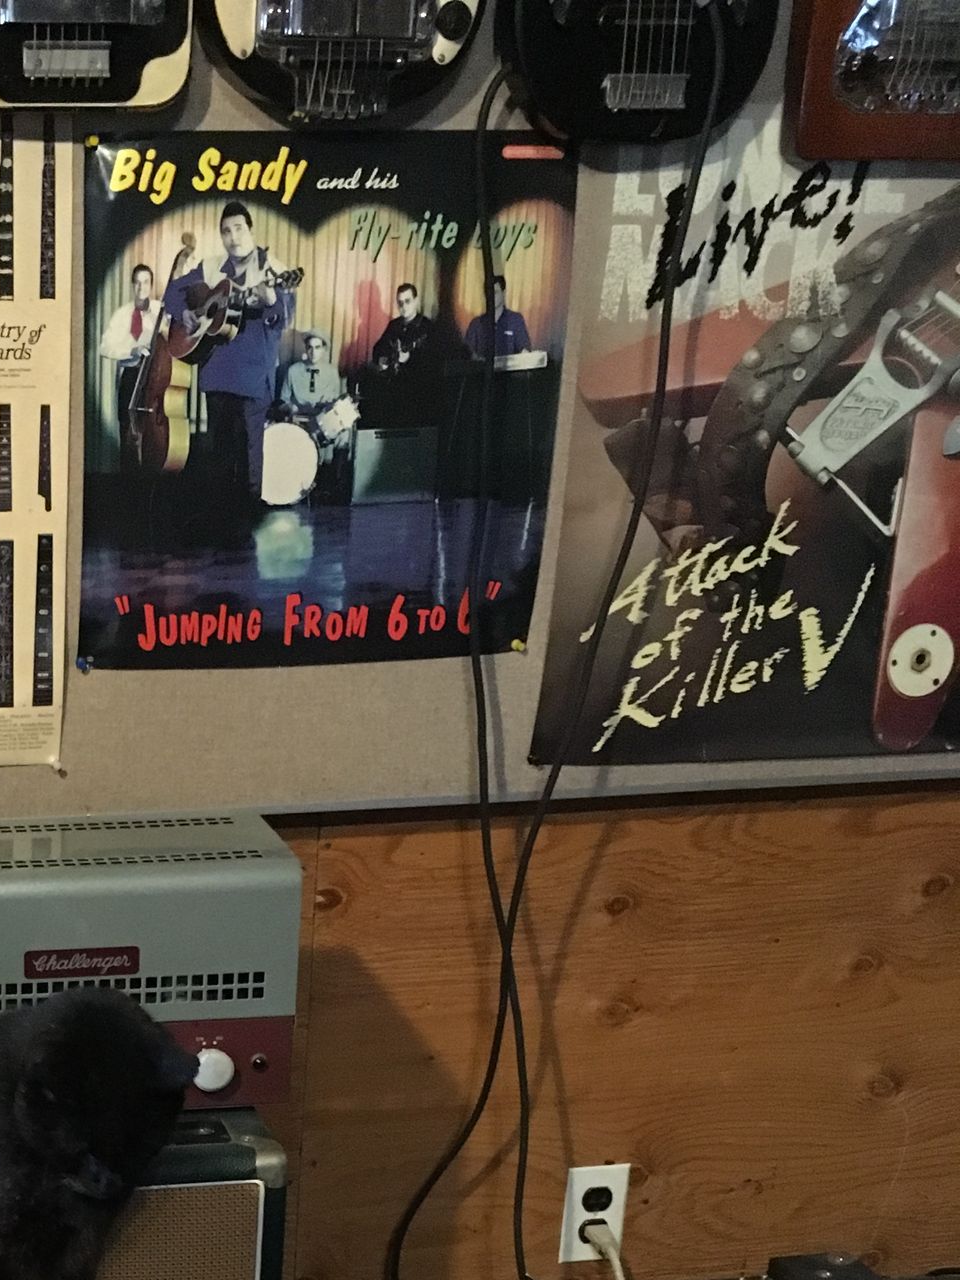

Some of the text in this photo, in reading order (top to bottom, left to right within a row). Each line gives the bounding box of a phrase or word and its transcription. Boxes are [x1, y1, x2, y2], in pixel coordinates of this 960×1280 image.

[109, 146, 399, 205] Big Sandy and his
[645, 161, 871, 310] Live!
[29, 324, 46, 344] of
[579, 499, 800, 642] Attack
[284, 593, 368, 646] FROM
[388, 594, 408, 641] 6
[417, 605, 446, 635] TO
[632, 587, 797, 669] of the
[592, 563, 876, 752] Killer V
[32, 953, 131, 974] Challenger
